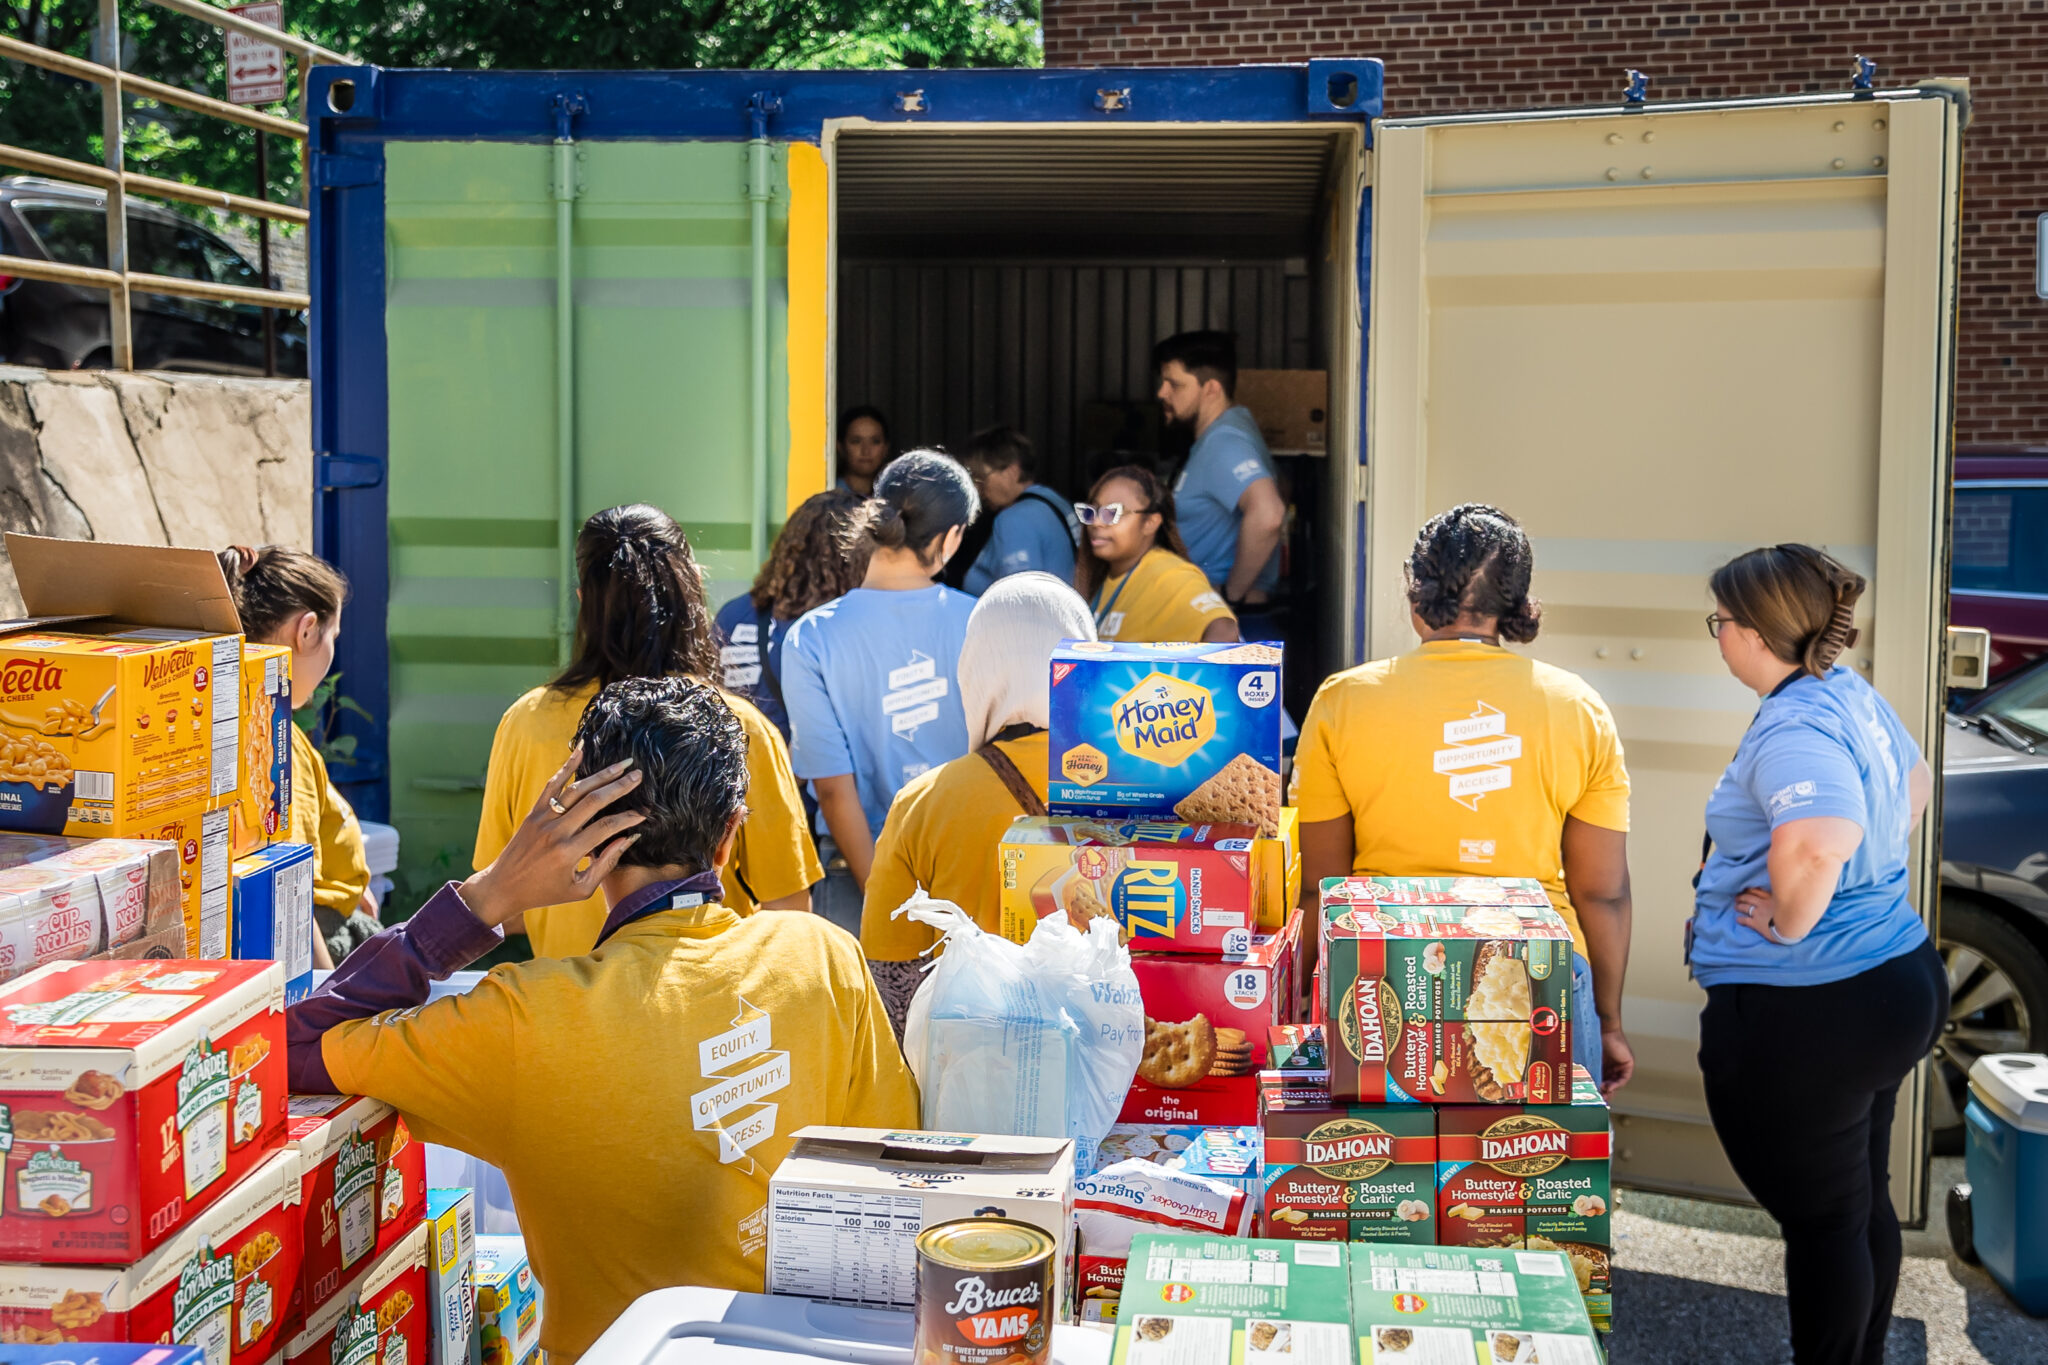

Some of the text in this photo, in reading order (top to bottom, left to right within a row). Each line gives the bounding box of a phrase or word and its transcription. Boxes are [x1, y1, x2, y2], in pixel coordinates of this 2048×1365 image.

[0, 658, 63, 694] eeta
[144, 648, 194, 688] Velveeta
[1248, 676, 1263, 690] 4
[7, 694, 35, 702] CHEESE
[1119, 696, 1206, 728] Honey
[1134, 717, 1198, 748] Maid
[1065, 760, 1103, 774] Honey
[1061, 789, 1075, 799] NO
[187, 844, 194, 854] 10
[1123, 860, 1179, 939] RITZ
[48, 907, 80, 933] CUP
[116, 903, 145, 931] NOOD
[34, 920, 91, 957] NOODLES
[1236, 935, 1248, 952] 30
[1532, 964, 1548, 975] 4
[1234, 974, 1257, 990] 18
[1404, 956, 1417, 1010] Roasted
[1417, 975, 1427, 1010] Garlic
[1358, 979, 1384, 1062] IDAHOAN
[1409, 1013, 1427, 1027] &
[1101, 1023, 1124, 1046] Pay
[711, 1030, 759, 1061] EQUITY.
[1404, 1029, 1418, 1078] Buttery
[1416, 1030, 1429, 1091] Homestyle
[178, 1050, 228, 1109] BOYARDEE
[699, 1065, 785, 1116] OPPORTUNITY.
[1162, 1095, 1180, 1105] the
[1389, 1083, 1409, 1101] NEW!
[1532, 1087, 1548, 1101] 4
[181, 1084, 226, 1119] VARIETY PACK
[1145, 1108, 1199, 1122] original
[160, 1115, 176, 1154] 12
[730, 1120, 765, 1151] CESS.
[1306, 1137, 1391, 1163] IDAHOAN
[1482, 1133, 1566, 1160] IDAHOAN
[28, 1160, 81, 1174] BOYARDEE
[335, 1141, 375, 1189] BOYARDEE
[1440, 1164, 1459, 1184] NEW!
[336, 1170, 374, 1202] VARIETY PACK
[1265, 1167, 1283, 1186] NEW!
[1465, 1178, 1517, 1192] Buttery
[1536, 1177, 1591, 1189] Roasted
[776, 1189, 833, 1199] Nutrition Facts
[1099, 1185, 1145, 1204] Sugar
[1288, 1182, 1341, 1195] Buttery
[1342, 1187, 1358, 1204] &
[1360, 1182, 1415, 1194] Roasted
[1452, 1190, 1515, 1202] Homestyle
[1518, 1183, 1534, 1200] &
[1536, 1189, 1572, 1200] Garlic
[1275, 1194, 1339, 1206] Homestyle
[1360, 1194, 1395, 1204] Garlic
[321, 1198, 332, 1232] 12
[775, 1214, 805, 1222] Calories
[1151, 1194, 1219, 1224] Betty Crocker
[844, 1218, 861, 1226] 100
[872, 1220, 891, 1228] 100
[902, 1222, 920, 1231] 100
[174, 1254, 233, 1323] BOYARDEE
[945, 1276, 1040, 1315] Bruce's
[178, 1288, 230, 1333] VARIETY PACK
[460, 1270, 474, 1336] Welch's
[971, 1314, 1029, 1339] YAMS
[331, 1311, 377, 1365] BOYARDEE
[360, 1339, 375, 1355] PACK
[942, 1343, 1008, 1355] CUT SWEET POTATOES
[968, 1356, 988, 1364] SYRUP
